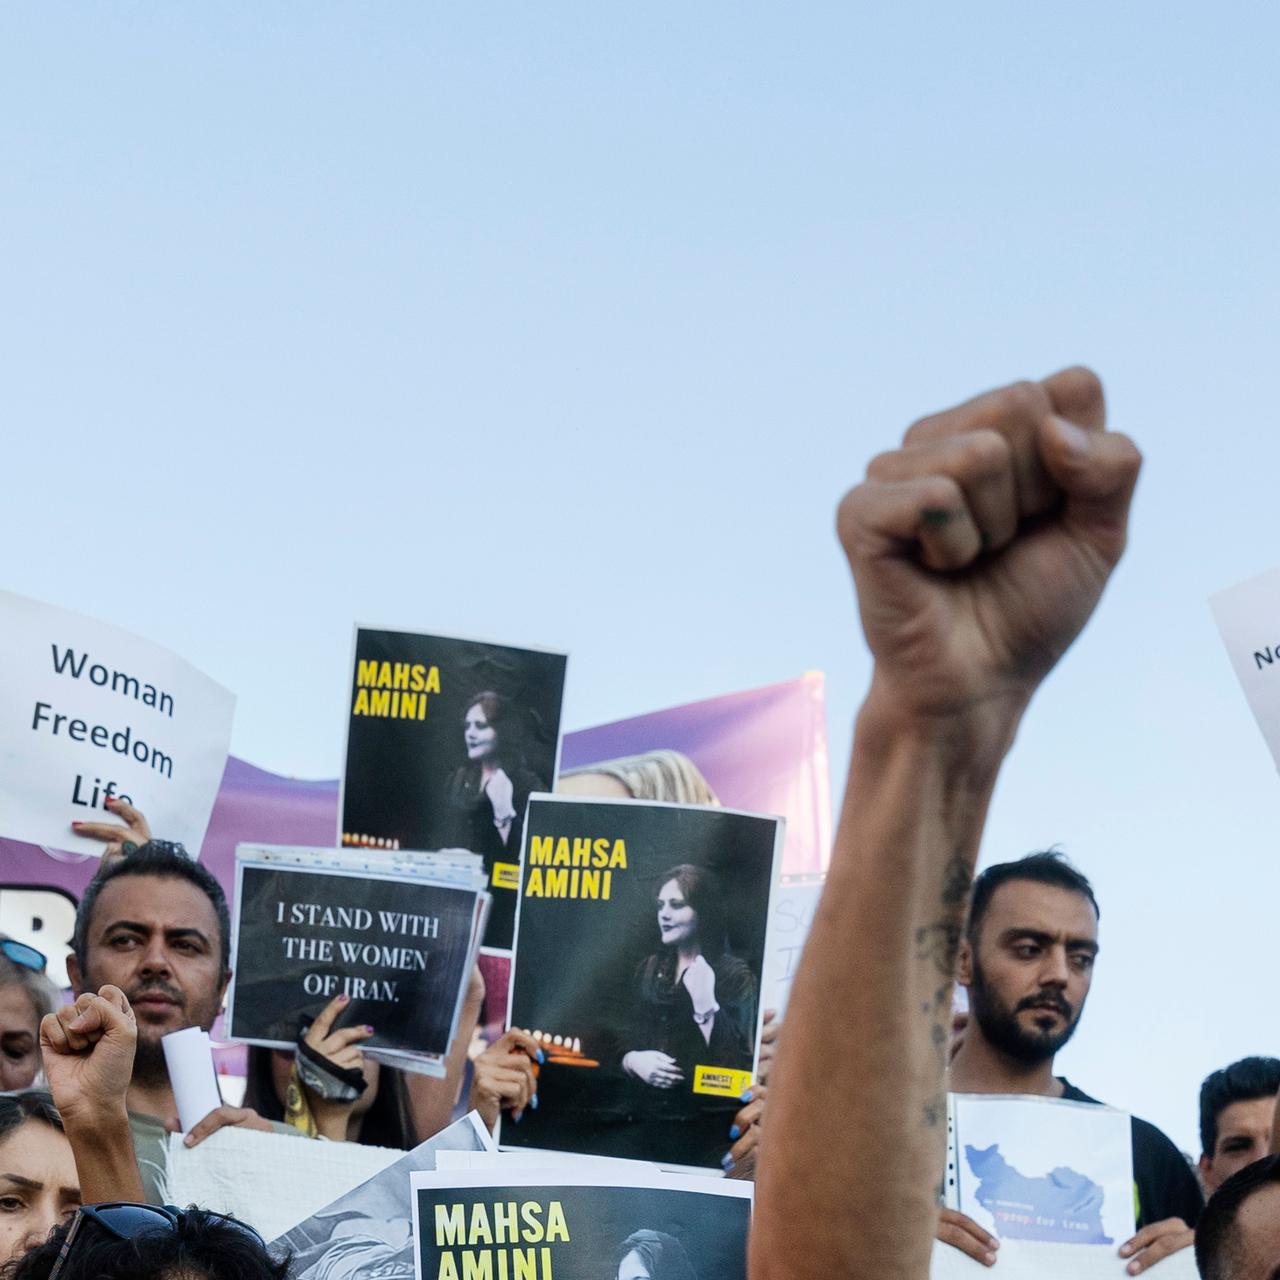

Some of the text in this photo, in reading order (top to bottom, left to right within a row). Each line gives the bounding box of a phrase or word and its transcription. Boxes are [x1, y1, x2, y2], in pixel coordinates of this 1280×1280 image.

[51, 643, 175, 718] Woman
[357, 660, 441, 694] MAHSA
[353, 688, 428, 721] AMINI
[31, 700, 174, 779] Freedom
[529, 836, 627, 869] MAHSA
[525, 868, 612, 900] AMINI
[276, 901, 439, 939] I STAND WITH
[281, 936, 429, 971] THE WOMEN
[303, 973, 400, 1003] OF IRAN.
[434, 1201, 570, 1246] MAHSA
